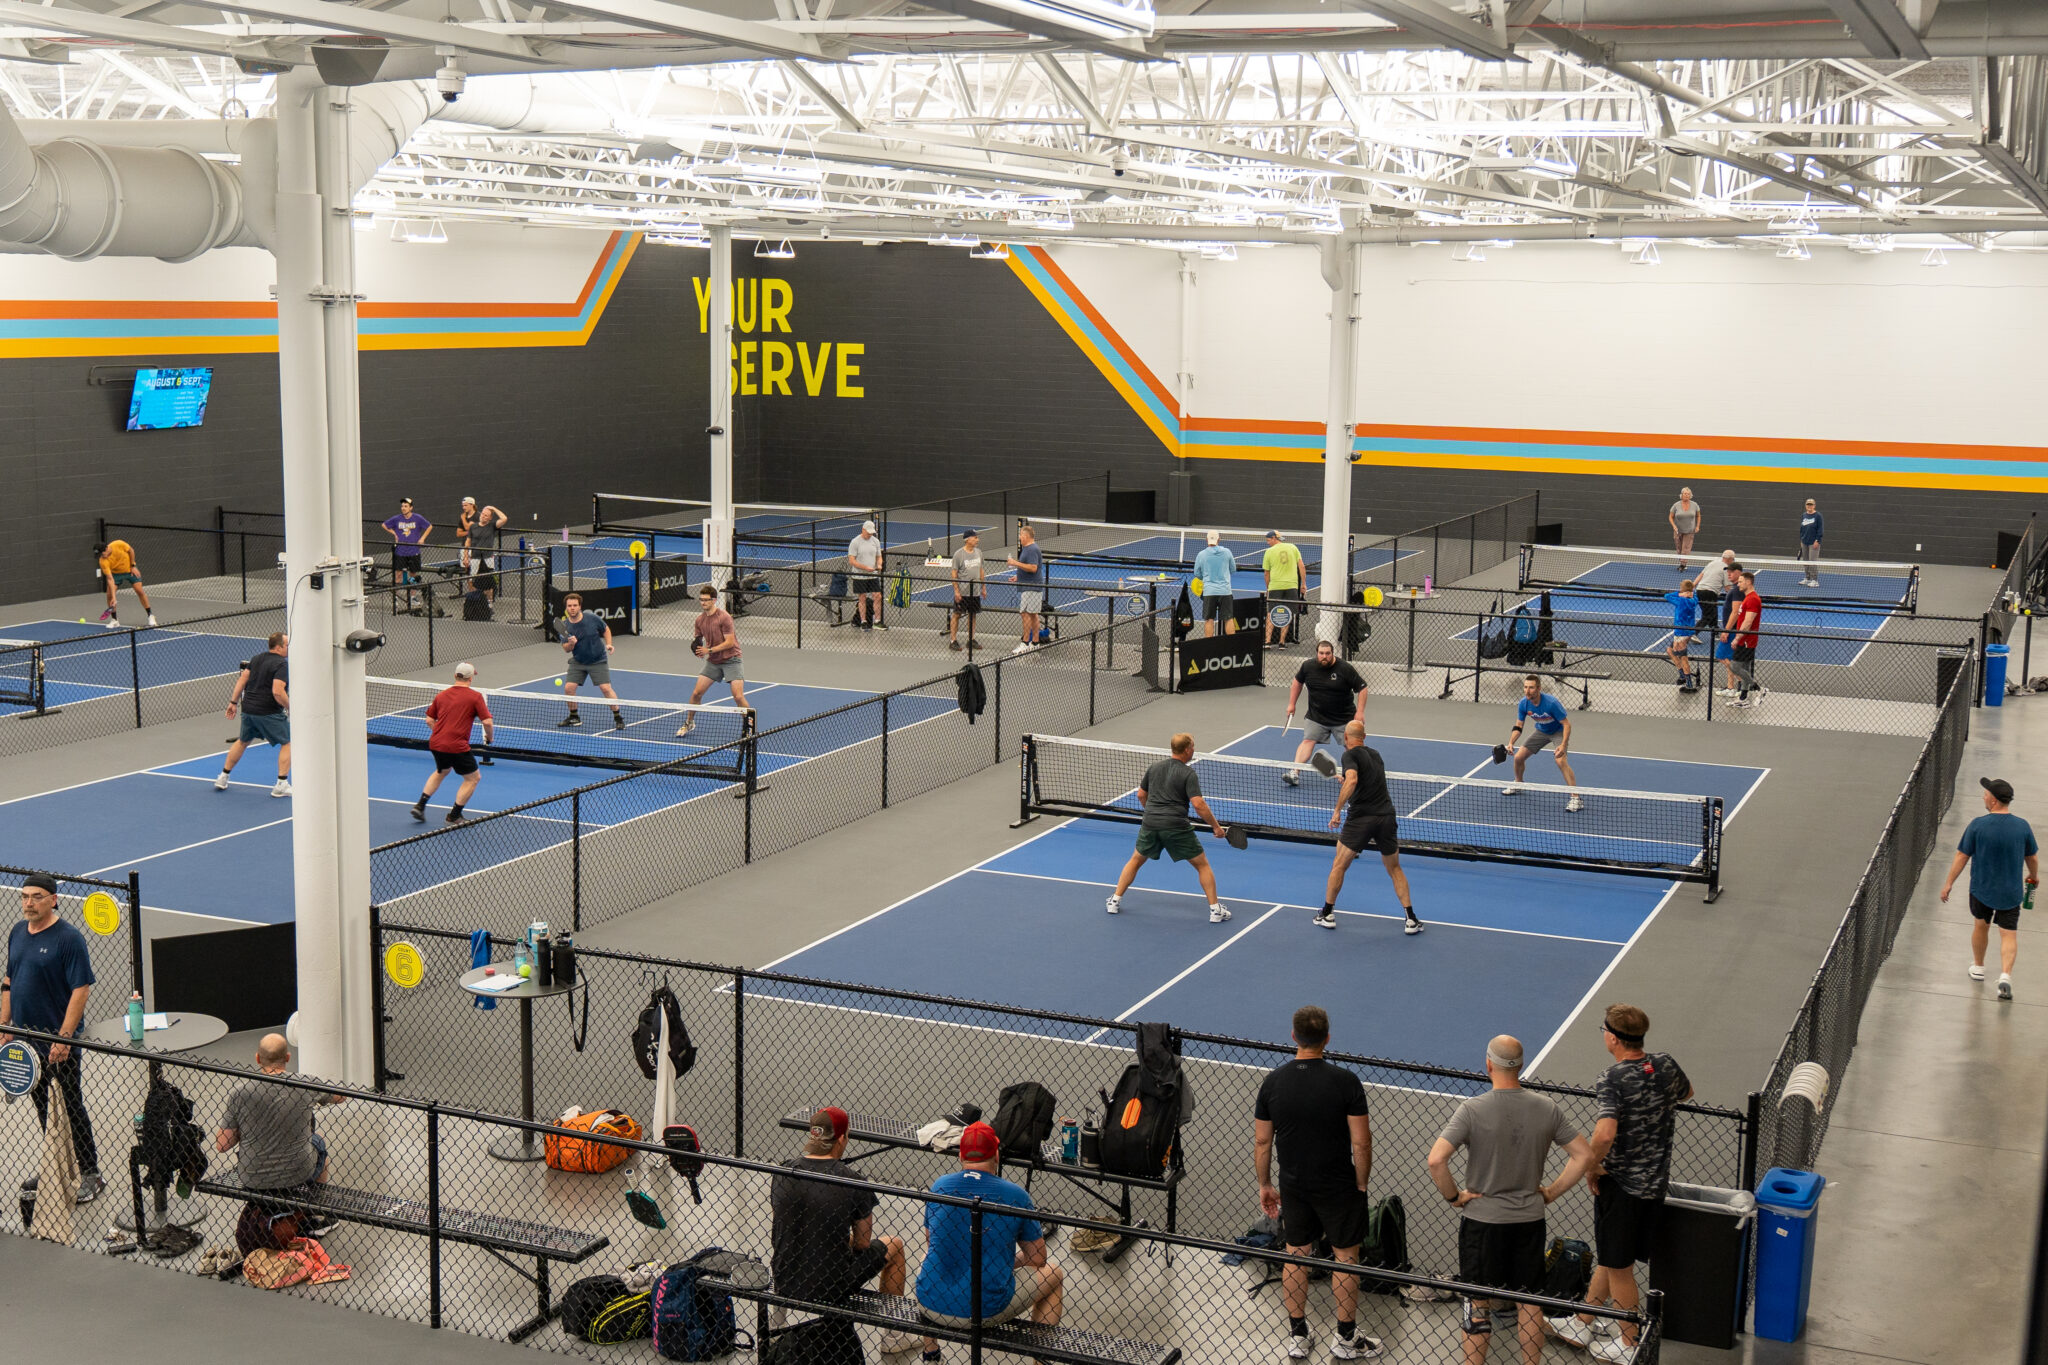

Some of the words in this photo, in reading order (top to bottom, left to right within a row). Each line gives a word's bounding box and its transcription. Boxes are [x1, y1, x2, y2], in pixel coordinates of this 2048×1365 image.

[692, 276, 793, 333] YUR
[146, 377, 176, 387] AUGUST
[183, 376, 202, 386] SEPT
[660, 574, 685, 590] JOOLA
[582, 606, 626, 620] OLA
[1201, 653, 1254, 673] JOOLA
[94, 902, 110, 929] 5
[396, 952, 413, 981] 6
